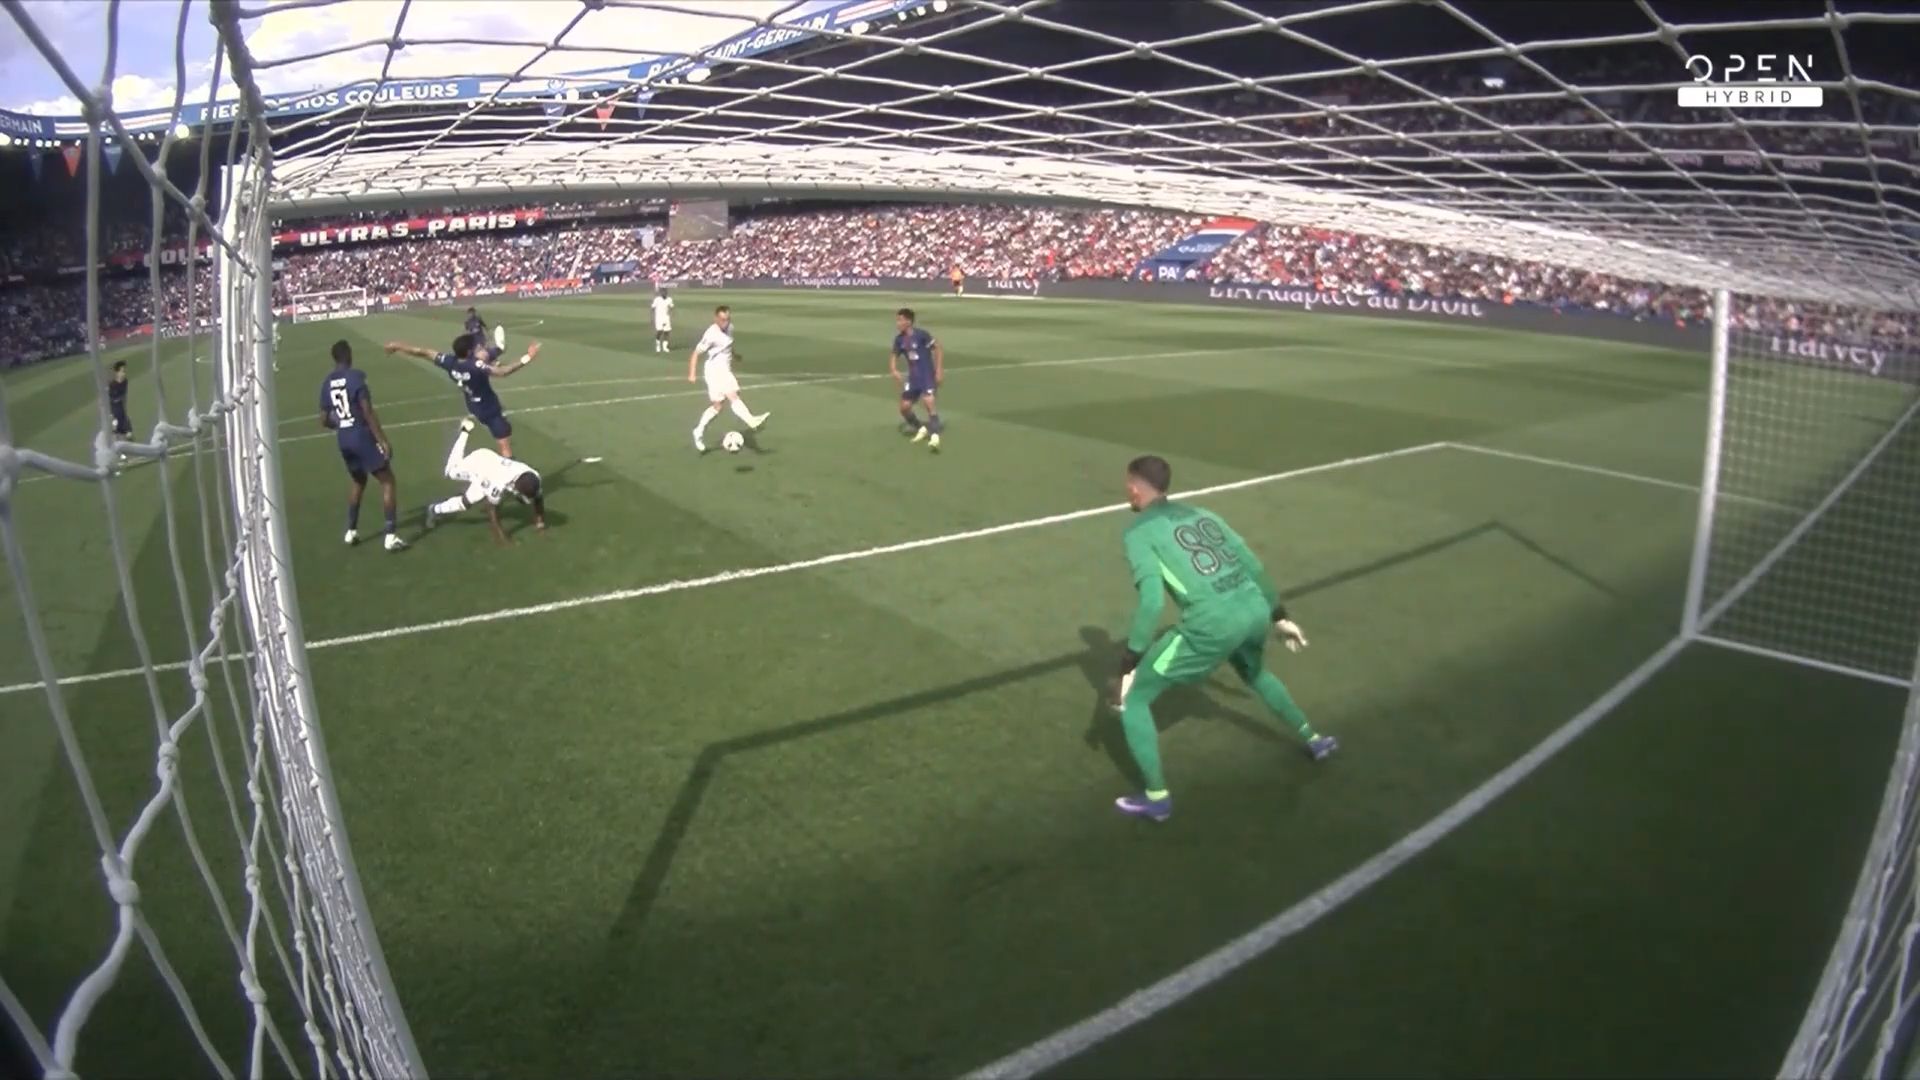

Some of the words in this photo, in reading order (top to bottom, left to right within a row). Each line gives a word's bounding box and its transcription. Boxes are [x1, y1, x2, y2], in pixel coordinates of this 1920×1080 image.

[345, 83, 459, 103] COULEURS
[301, 222, 409, 247] ULTRAS
[428, 214, 516, 237] PARIS
[330, 389, 351, 418] 51
